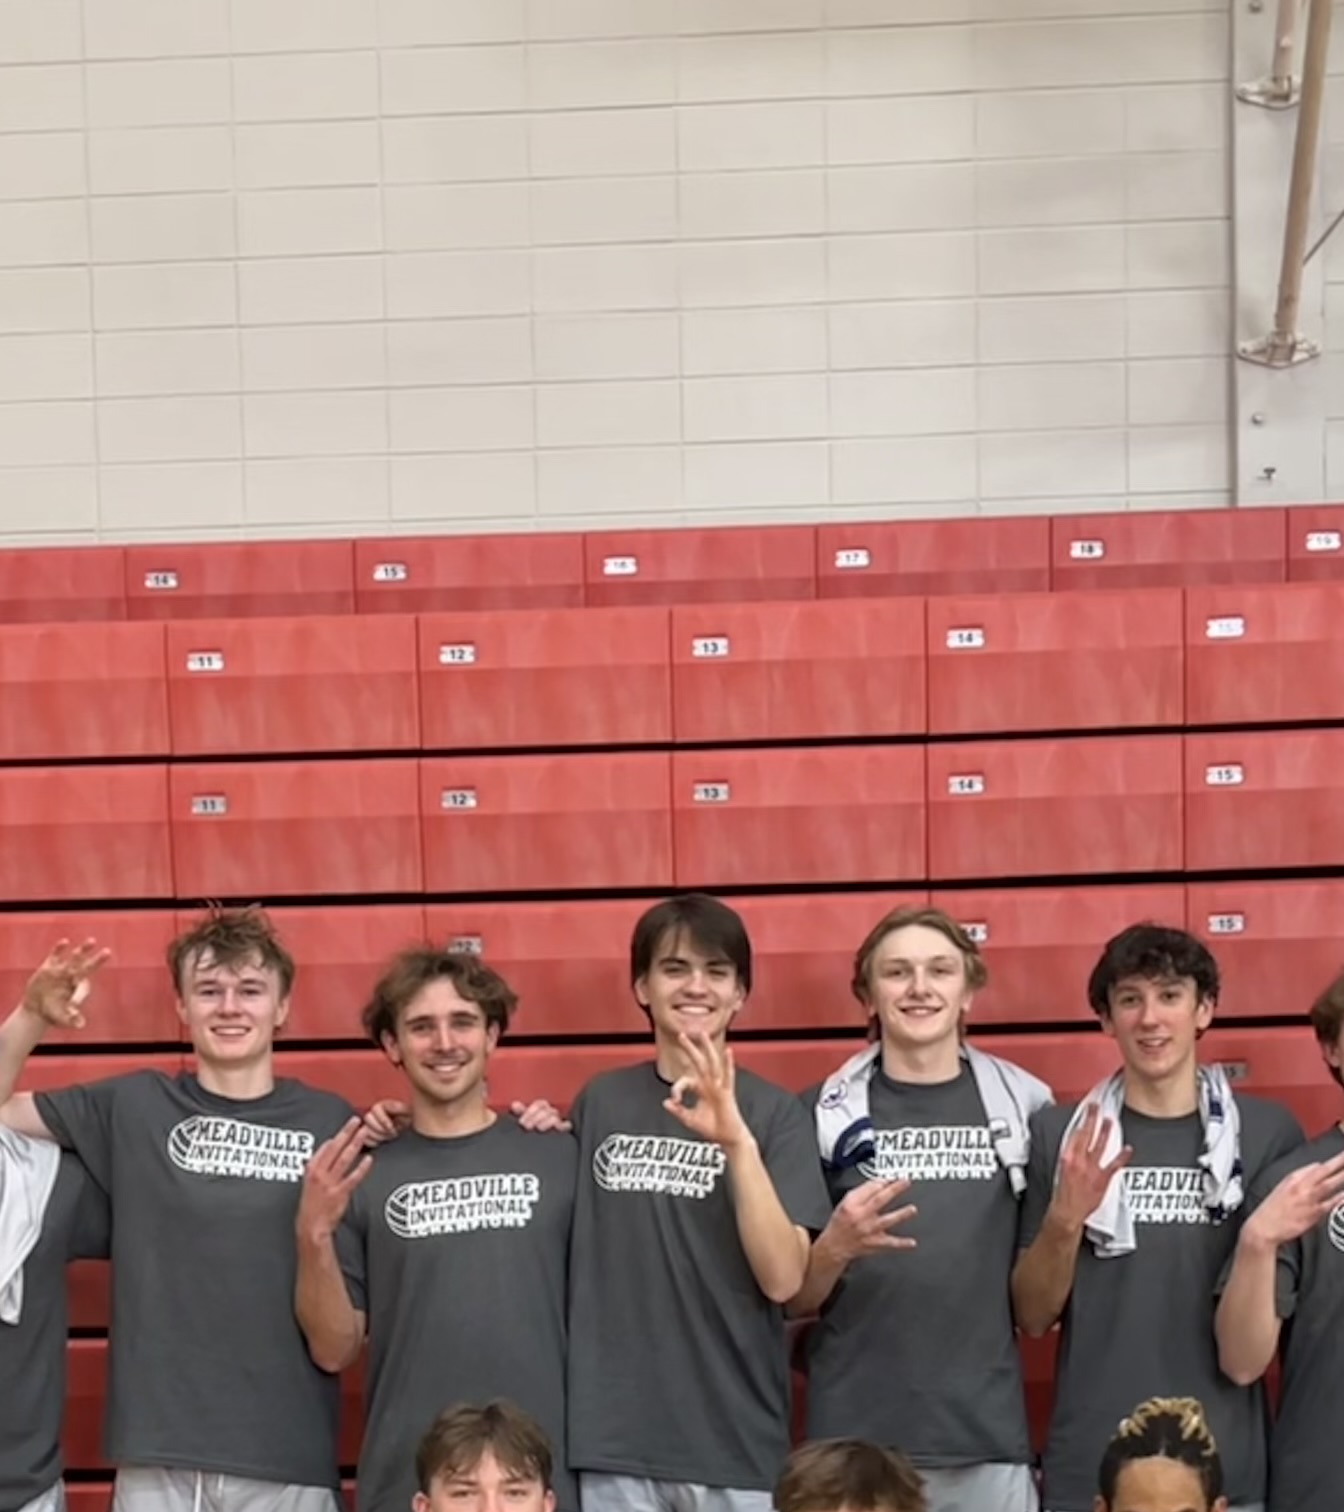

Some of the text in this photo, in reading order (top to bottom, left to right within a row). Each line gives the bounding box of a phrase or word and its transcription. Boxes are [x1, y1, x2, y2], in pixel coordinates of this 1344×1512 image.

[197, 1121, 309, 1153] MEADVILLE
[881, 1129, 989, 1150] MEADVILL
[188, 1144, 300, 1169] INVITATIONAL
[613, 1139, 721, 1168] MEADVILLE
[877, 1151, 992, 1169] INVITATIONAL
[609, 1162, 710, 1185] INVITATIONAL
[412, 1176, 534, 1207] MEADVILLE
[410, 1200, 526, 1225] INVITATIONAL
